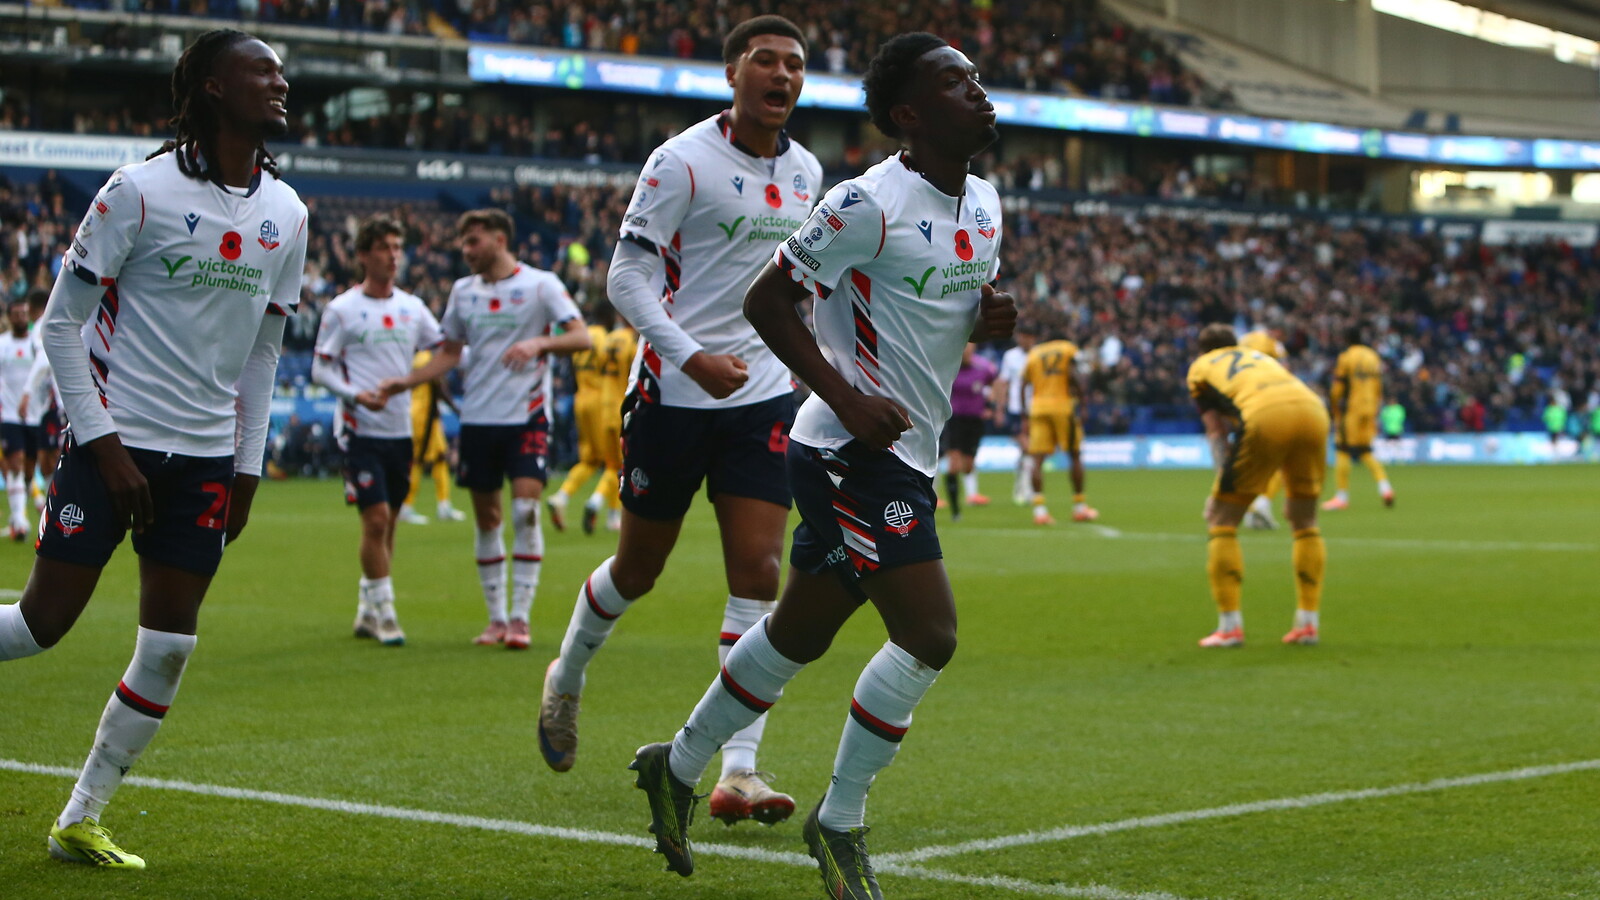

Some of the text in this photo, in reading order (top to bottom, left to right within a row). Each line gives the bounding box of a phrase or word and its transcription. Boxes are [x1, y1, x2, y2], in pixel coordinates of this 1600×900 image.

[33, 139, 126, 161] Community
[748, 229, 790, 243] plumbi
[804, 236, 814, 248] EFL
[198, 257, 262, 279] victorian
[940, 275, 986, 299] plumbi
[196, 481, 232, 530] 2
